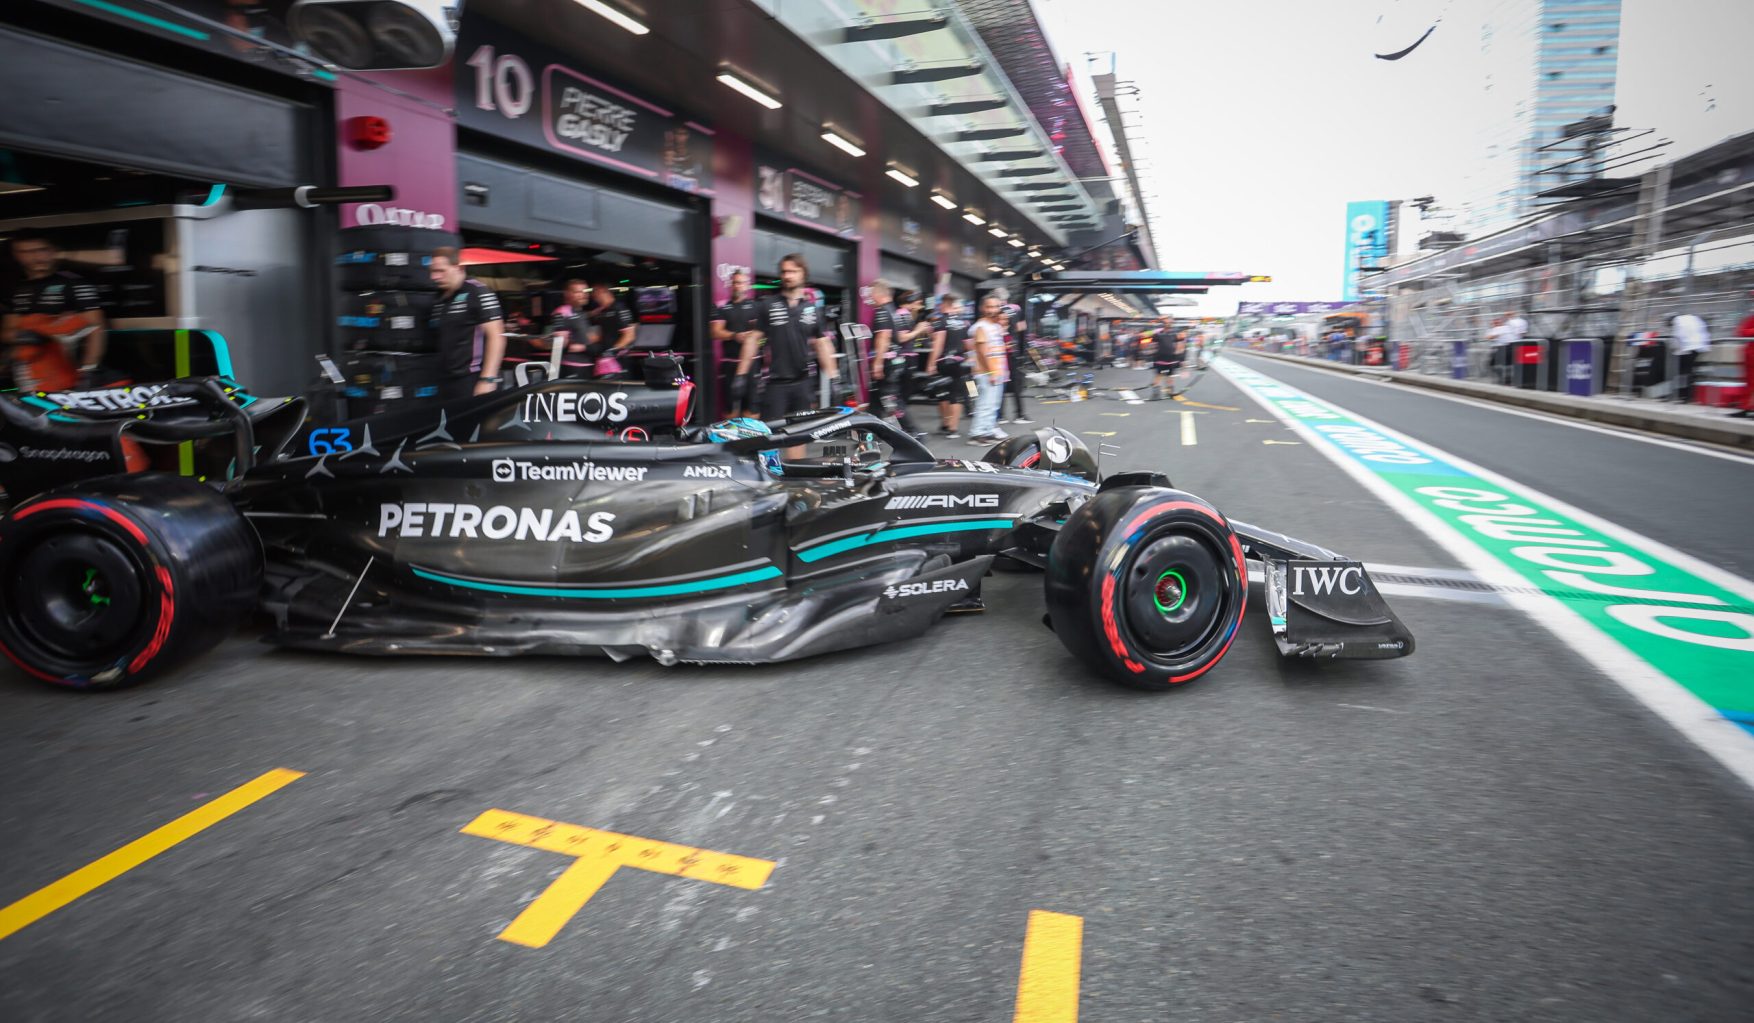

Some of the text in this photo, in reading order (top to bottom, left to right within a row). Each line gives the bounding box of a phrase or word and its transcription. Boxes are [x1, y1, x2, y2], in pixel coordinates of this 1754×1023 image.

[466, 44, 535, 119] 10
[561, 86, 637, 132] PIERRE
[557, 113, 630, 152] GASLY
[523, 391, 629, 423] INEOS
[19, 446, 111, 462] Snapdragon
[308, 428, 353, 457] 63
[516, 461, 648, 482] TeamViewer
[683, 465, 718, 478] AMD
[926, 494, 999, 508] AMG
[378, 502, 616, 543] PETRONAS
[898, 578, 969, 597] SOLERA
[1292, 566, 1362, 595] IWC
